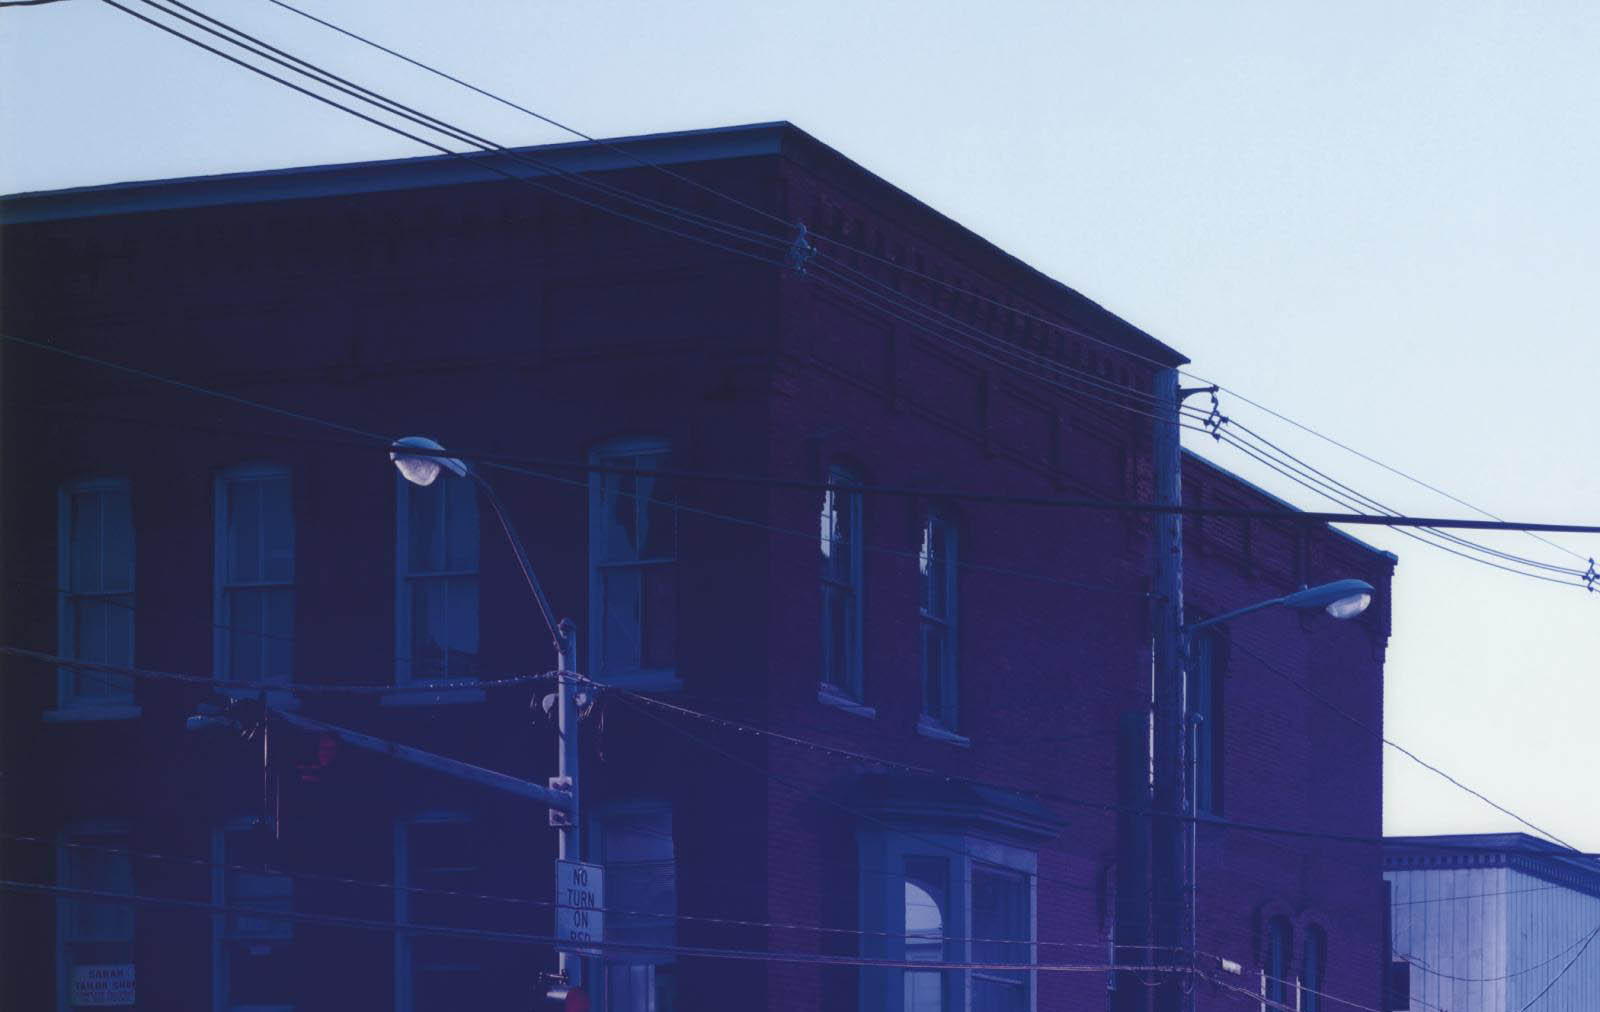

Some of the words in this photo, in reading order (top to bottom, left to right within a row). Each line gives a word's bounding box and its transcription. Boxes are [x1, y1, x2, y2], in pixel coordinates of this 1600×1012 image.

[573, 869, 588, 887] NO
[567, 888, 595, 908] TURN
[574, 910, 588, 928] ON
